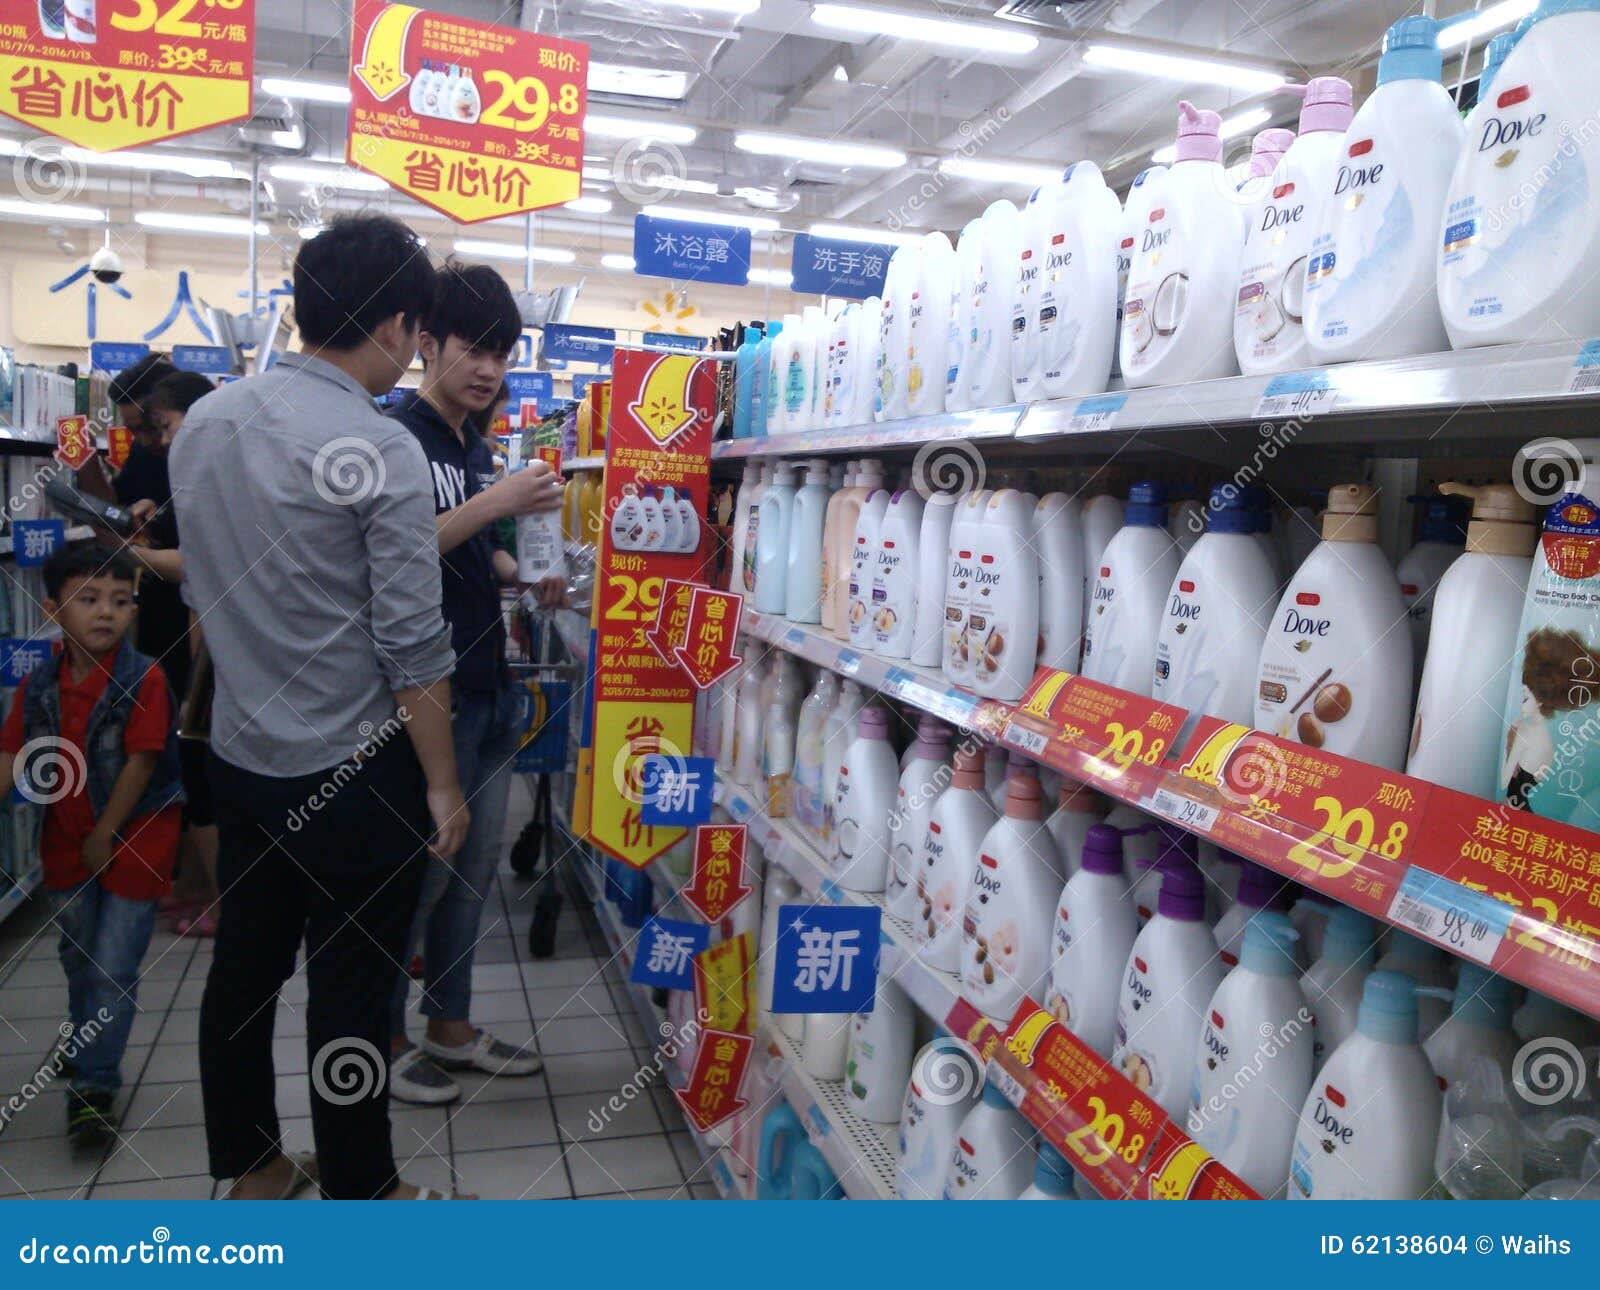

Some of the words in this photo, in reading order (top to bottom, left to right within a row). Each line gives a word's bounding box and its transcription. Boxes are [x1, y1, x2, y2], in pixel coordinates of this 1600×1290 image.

[538, 48, 581, 73] 现价:
[10, 65, 184, 130] 省心价
[480, 69, 579, 133] 29.8
[1479, 113, 1547, 152] Dove
[404, 149, 531, 207] 省心价
[1334, 163, 1384, 195] Dove
[1261, 203, 1304, 231] Dove
[654, 232, 730, 264] 沐浴露
[1142, 228, 1172, 253] Dove
[812, 247, 883, 280] 洗手液
[1046, 251, 1072, 271] Dove
[431, 460, 467, 510] NY
[24, 528, 55, 558] 新
[853, 546, 870, 562] Dove
[878, 551, 900, 566] Dove
[610, 553, 648, 572] 现价:
[952, 562, 973, 578] Dov
[975, 567, 1001, 586] Dove
[1095, 579, 1115, 601] Dove
[1551, 590, 1570, 600] Drop
[1170, 594, 1201, 621] Dove
[1283, 608, 1331, 637] Dove
[696, 595, 729, 668] 省心价
[11, 649, 43, 678] 新
[1083, 721, 1165, 780] 29.8
[656, 769, 701, 814] 新
[1375, 781, 1416, 813] 现价:
[924, 831, 944, 857] Dove
[1286, 795, 1409, 878] 29.8
[705, 829, 733, 902] 省心价
[974, 864, 1001, 894] Dove
[1459, 840, 1600, 907] 600毫升系列产品
[647, 930, 697, 977] 新
[793, 925, 861, 994] 新
[1128, 967, 1152, 1003] Dove
[1204, 1020, 1229, 1062] Dove
[701, 1037, 739, 1111] 省心价
[1313, 1096, 1355, 1145] Dove
[952, 1146, 979, 1182] Dove
